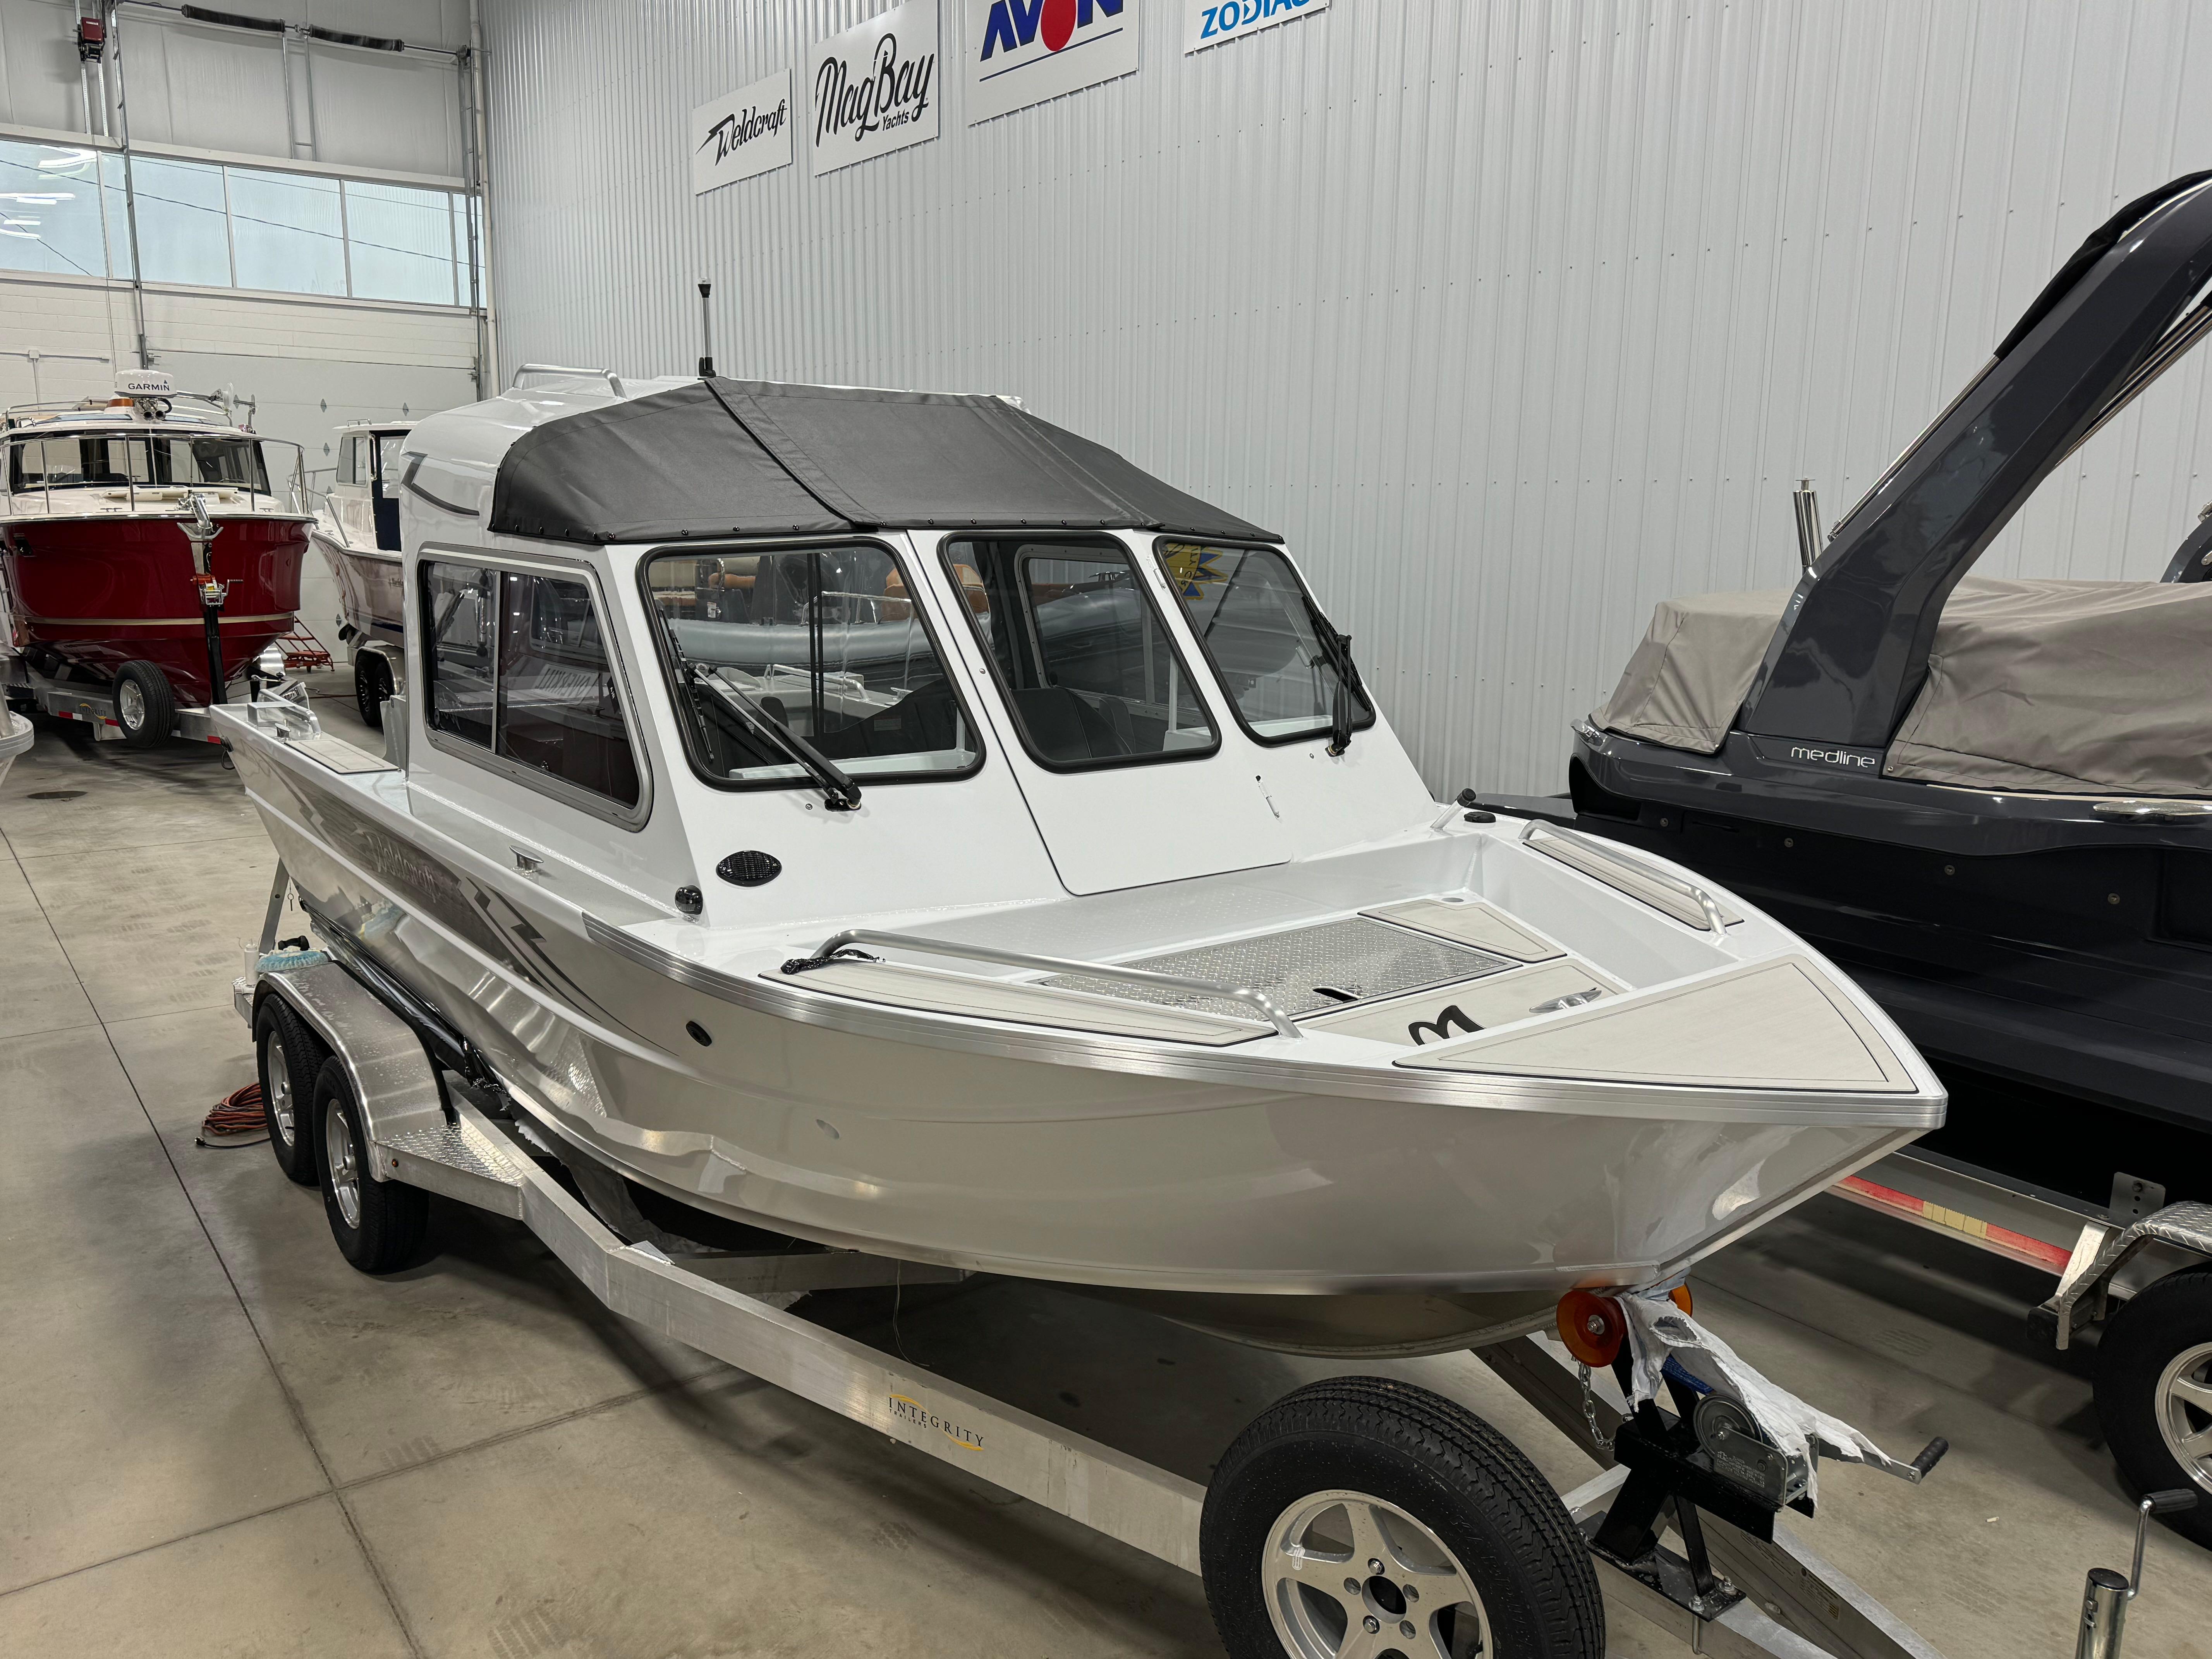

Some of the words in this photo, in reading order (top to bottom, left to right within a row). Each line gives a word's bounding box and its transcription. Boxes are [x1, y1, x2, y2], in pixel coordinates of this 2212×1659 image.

[1200, 0, 1310, 40] ZODI
[883, 109, 910, 131] Yachts
[696, 98, 788, 166] Weldcraft
[128, 383, 170, 391] GARMIN
[1791, 747, 1875, 768] medline
[889, 1409, 927, 1428] TRAILERS
[889, 1397, 984, 1447] INTEGRITY
